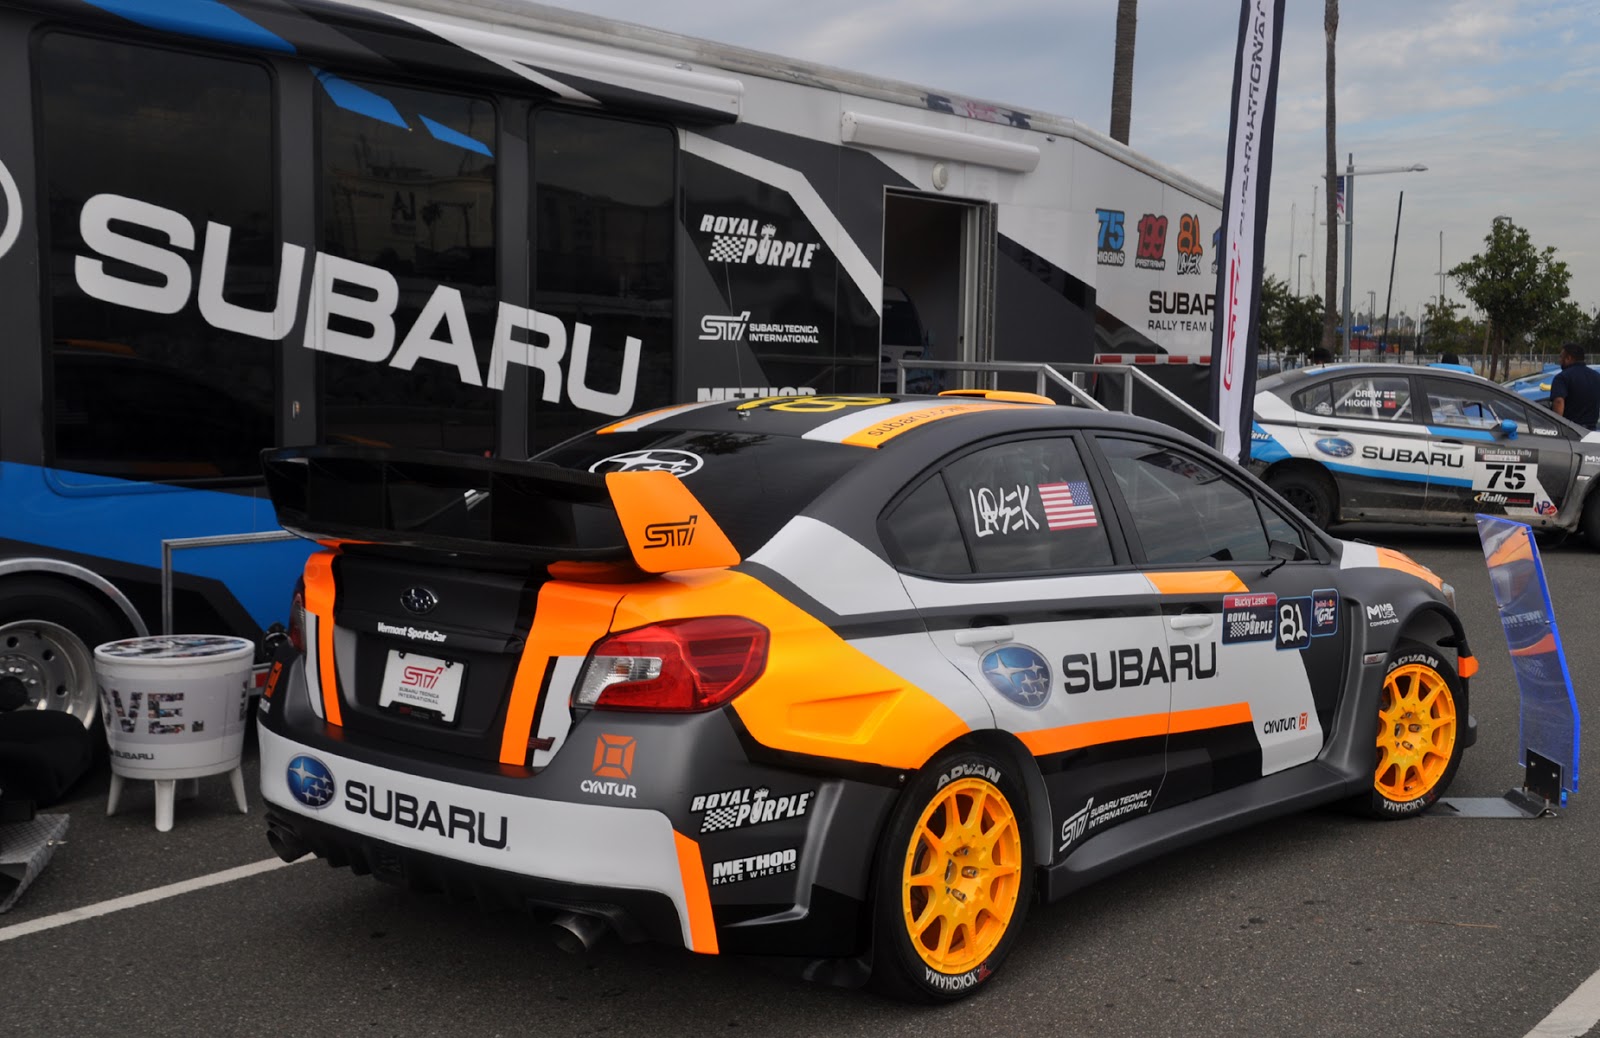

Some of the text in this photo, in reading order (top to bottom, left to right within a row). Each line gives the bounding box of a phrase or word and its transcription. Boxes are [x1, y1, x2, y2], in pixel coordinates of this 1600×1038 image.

[700, 214, 758, 237] ROYAL
[1095, 208, 1125, 250] 75
[1177, 213, 1203, 256] 81
[1137, 214, 1168, 260] 199
[741, 237, 816, 269] PURPLE
[1097, 251, 1125, 267] HIGGINS
[75, 193, 642, 418] SUBARU
[1149, 290, 1216, 316] SUBAR
[749, 323, 819, 334] SUBARU TECNICA
[1148, 320, 1178, 331] RALLY
[1180, 320, 1207, 332] TEAM
[749, 333, 819, 343] INTERNATIONAL
[1344, 399, 1382, 408] HIGGINS
[1355, 390, 1382, 398] DREW
[1362, 446, 1464, 468] SUBARU
[1486, 463, 1526, 490] 75
[1479, 492, 1508, 505] Rally
[1235, 597, 1268, 608] Bucky Lasek
[378, 622, 408, 635] Vermont
[1227, 612, 1250, 623] ROYAL
[1244, 619, 1273, 636] PURPLE
[1279, 603, 1308, 644] 81
[1062, 641, 1217, 695] SUBARU
[1387, 653, 1439, 673] ADVAN
[398, 692, 438, 704] INTERNATIONAL
[399, 686, 419, 695] SUBARU
[1264, 715, 1296, 734] CYNTUR
[114, 751, 154, 760] SUBARU
[937, 763, 1001, 791] ADVAN
[580, 779, 637, 798] CYNTUR
[691, 788, 751, 812] ROYAL
[735, 792, 809, 827] PURPLE
[1089, 789, 1152, 819] SUBARU TECNICA
[1383, 797, 1424, 813] YOKOHAMA
[345, 780, 508, 850] SUBARU
[1088, 799, 1148, 830] INTERNATIONAL
[713, 849, 797, 878] METHOD
[713, 863, 797, 885] RACE WHEELS
[924, 966, 978, 990] YOKOHAMA
